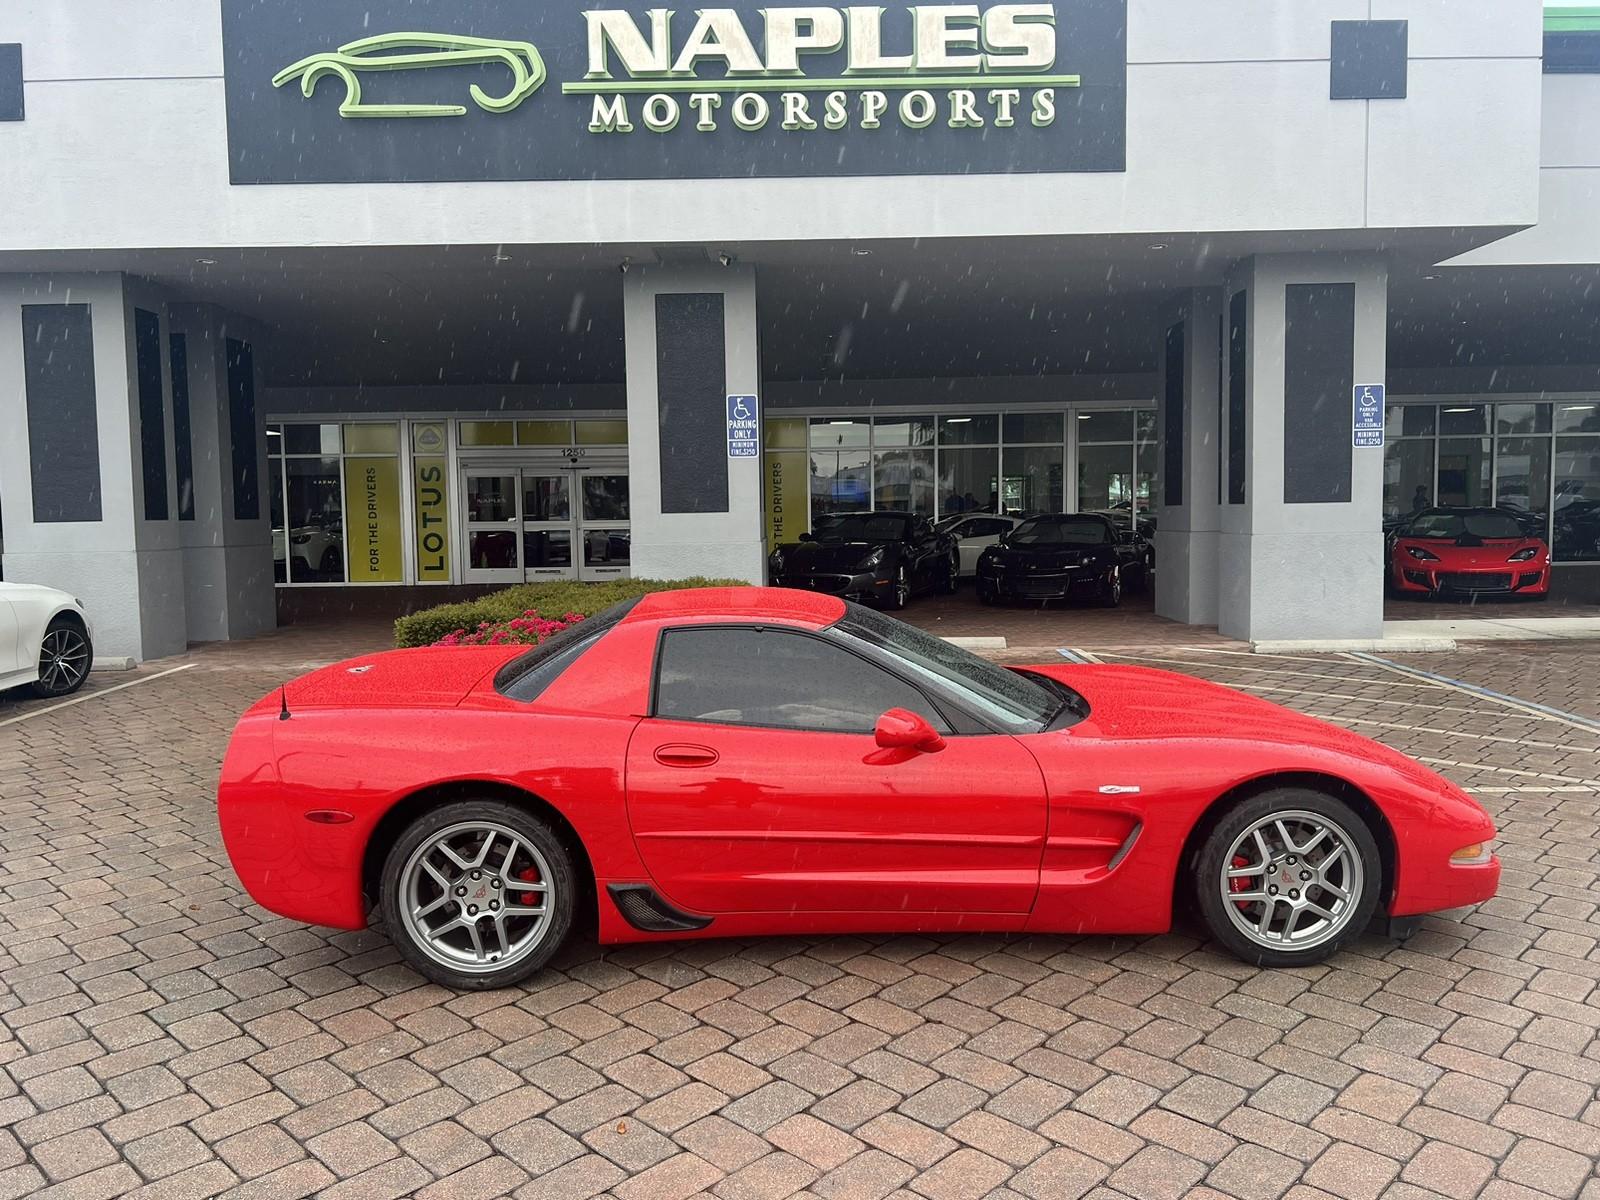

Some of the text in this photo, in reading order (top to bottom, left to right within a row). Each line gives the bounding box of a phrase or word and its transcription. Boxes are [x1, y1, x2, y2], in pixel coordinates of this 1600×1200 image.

[581, 3, 1057, 79] NAPLES
[587, 89, 1057, 132] MOTORSPORTS
[729, 419, 757, 429] PARKING
[734, 429, 751, 439] ONLY
[561, 448, 586, 457] 1250
[772, 462, 783, 513] DRIVERS
[366, 467, 380, 572] FOR THE DRIVERS
[421, 466, 444, 571] LOTUS
[773, 516, 783, 539] THE
